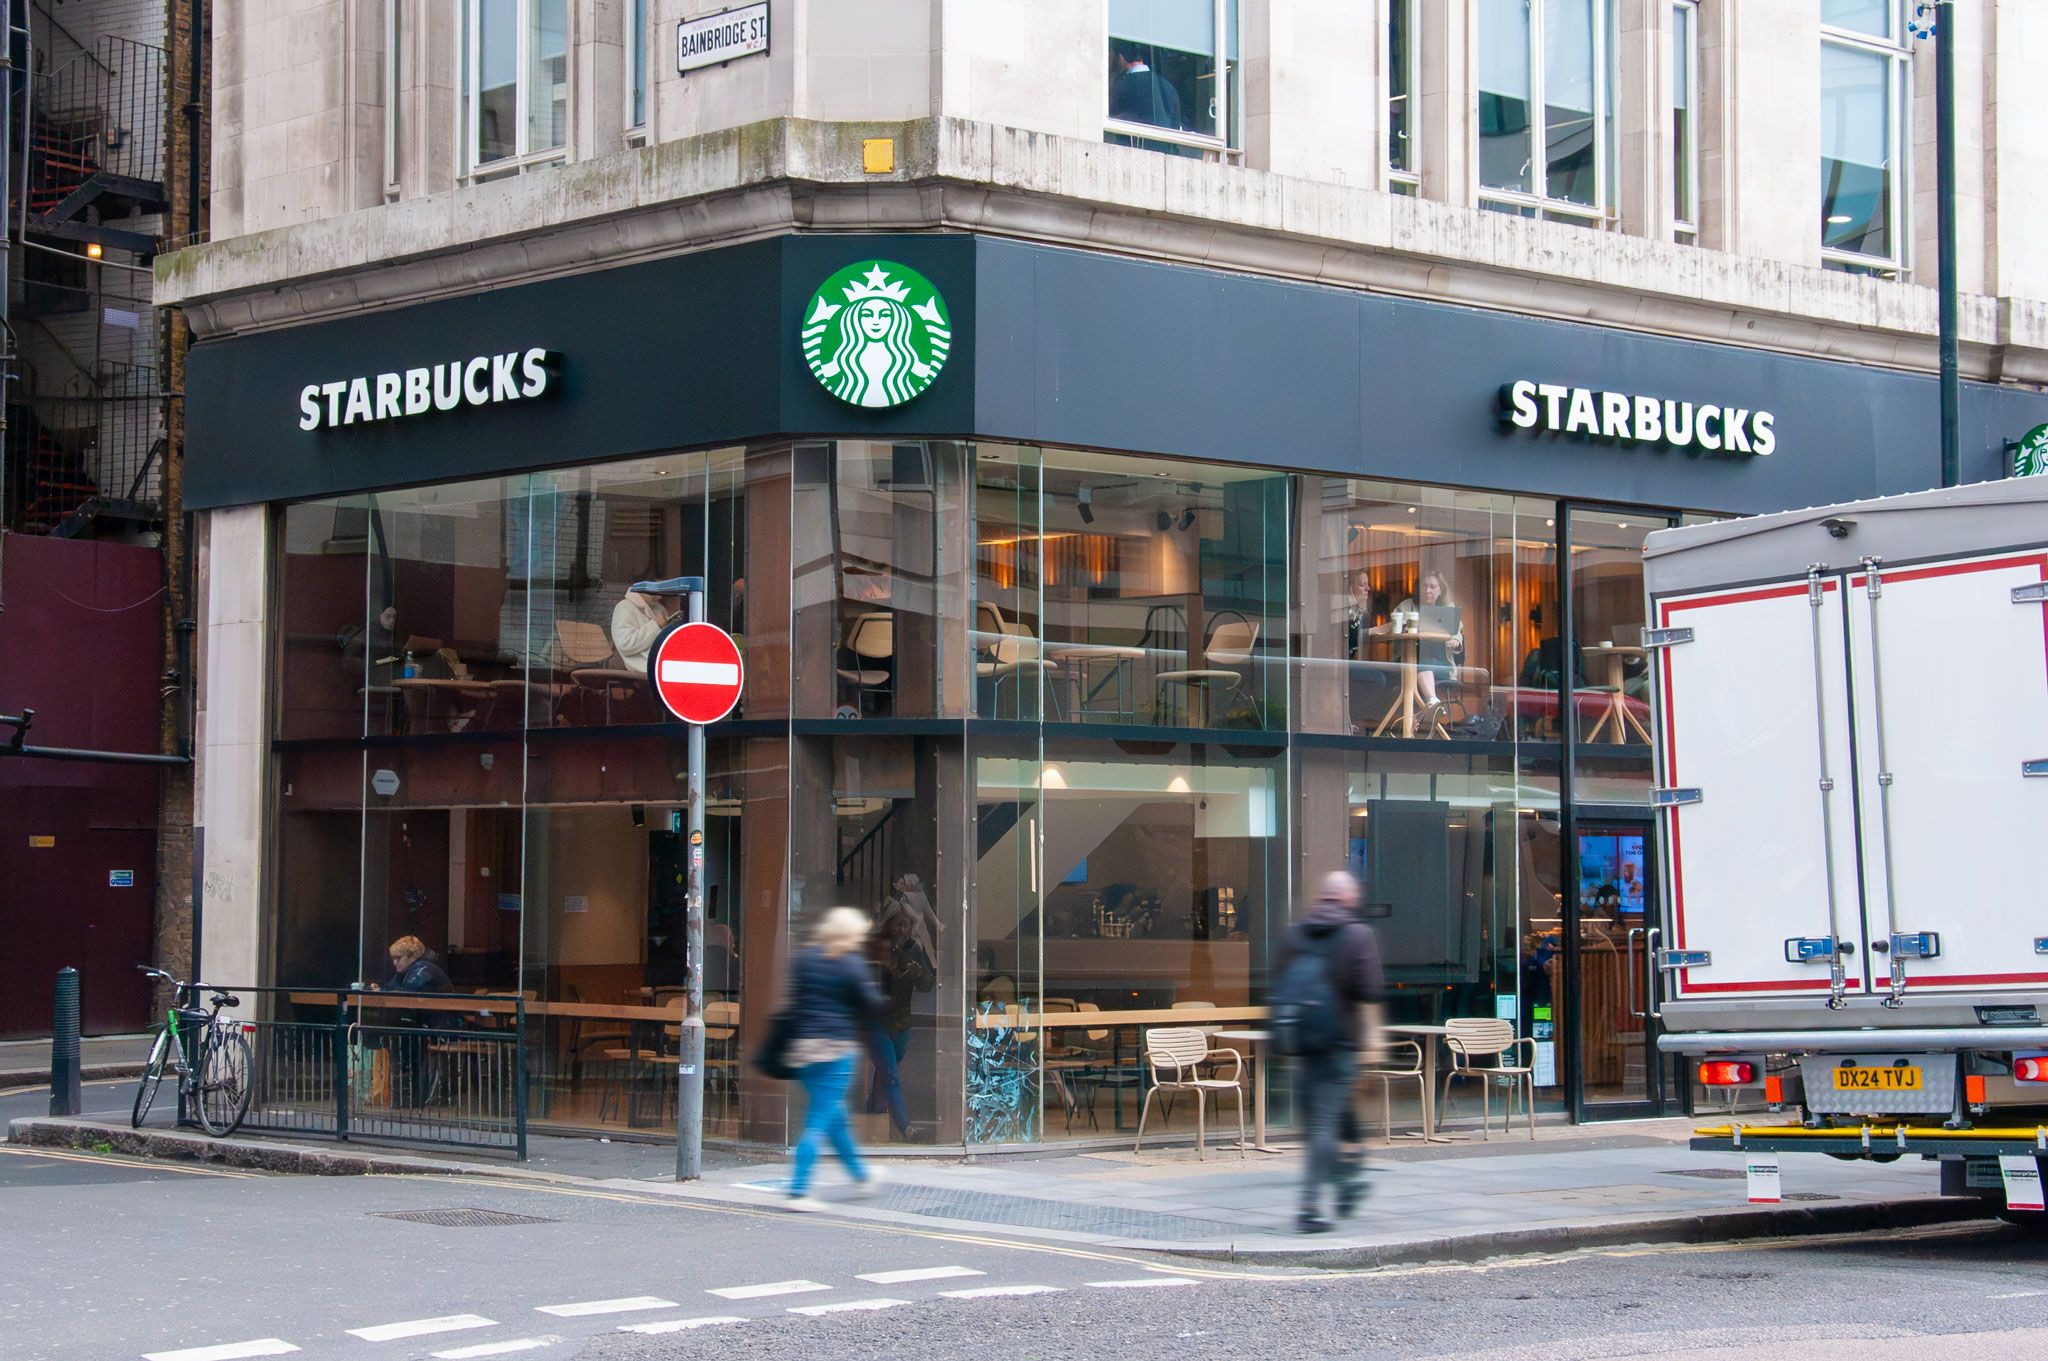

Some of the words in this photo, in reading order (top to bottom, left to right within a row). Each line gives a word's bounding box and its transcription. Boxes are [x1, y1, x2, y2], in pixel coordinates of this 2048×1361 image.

[681, 21, 747, 58] BAINBRIDGE
[751, 15, 767, 41] ST.
[299, 347, 547, 432] STARBUCKS
[1511, 379, 1776, 456] STARBUCKS
[1839, 1069, 1880, 1087] DX24
[1883, 1069, 1915, 1087] TVJ
